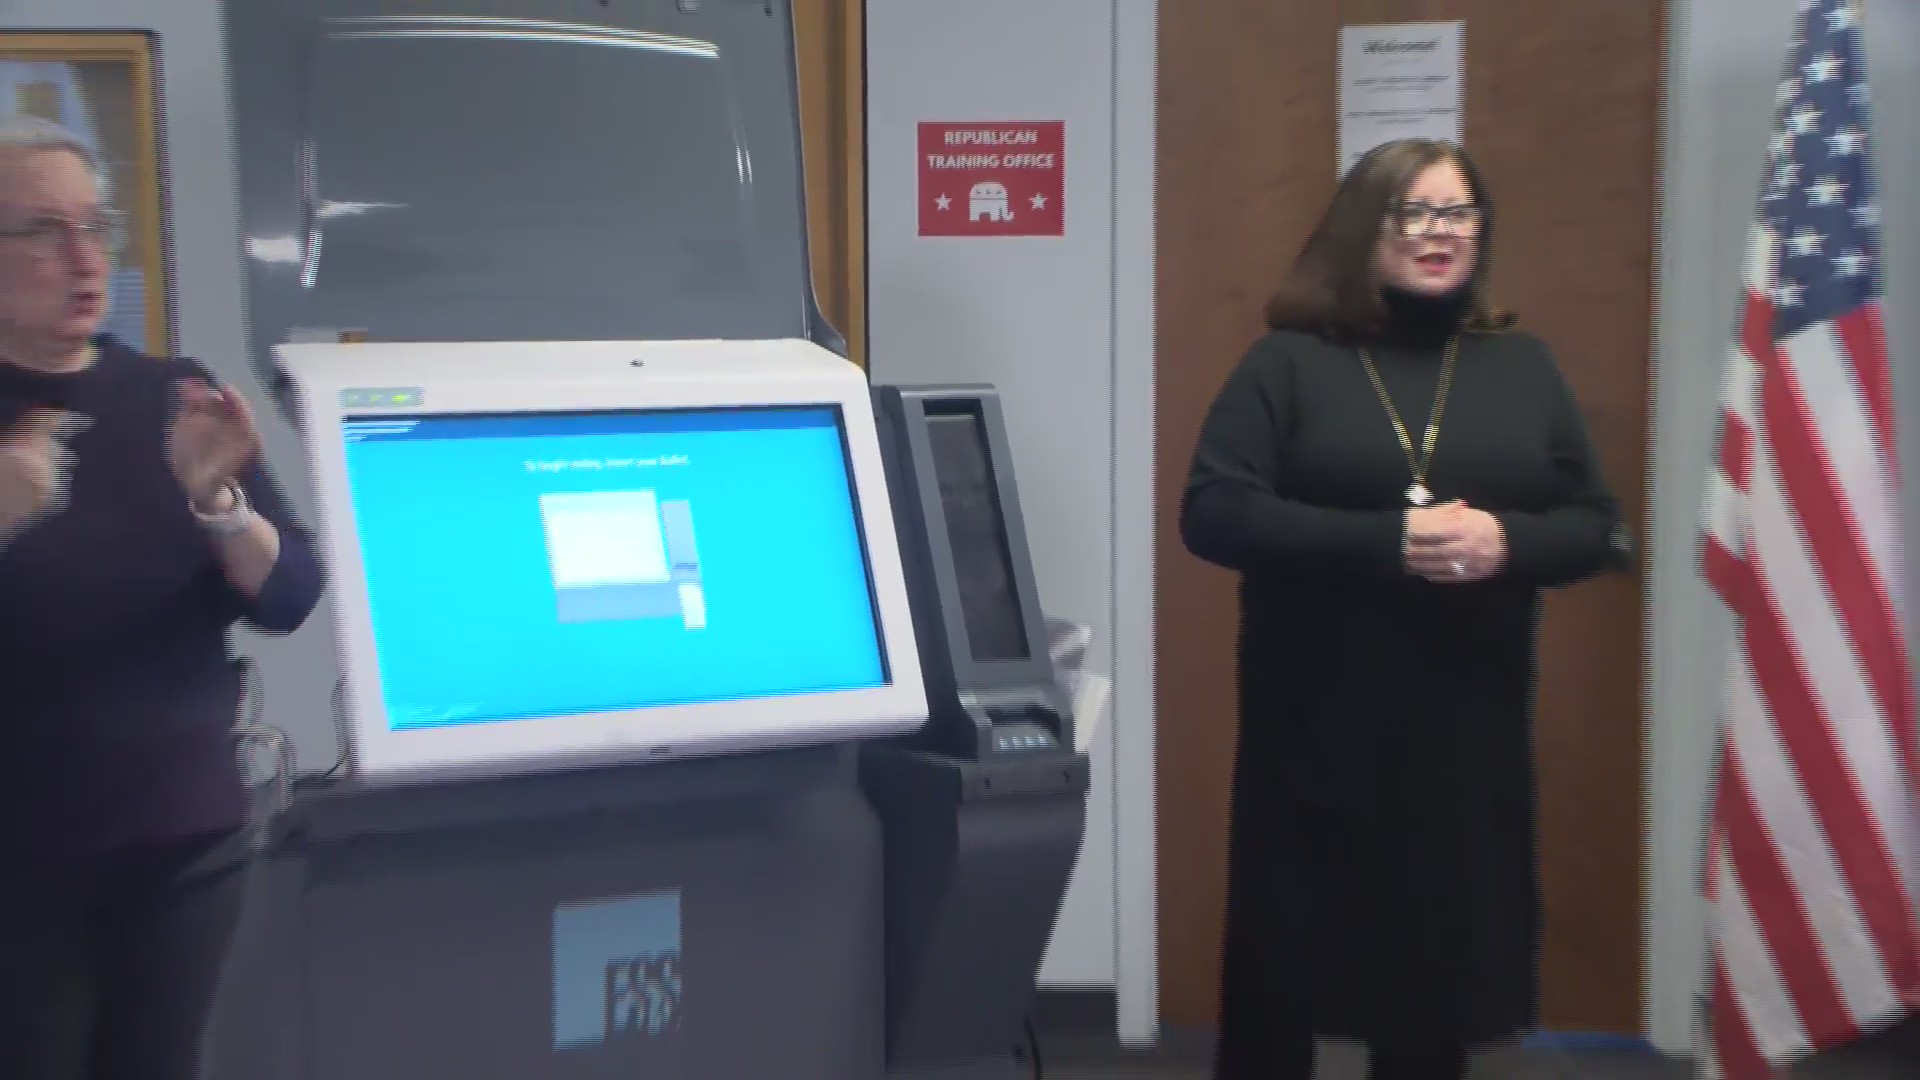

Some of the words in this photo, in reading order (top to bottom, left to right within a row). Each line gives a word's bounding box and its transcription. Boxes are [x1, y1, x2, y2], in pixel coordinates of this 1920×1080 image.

[944, 130, 1038, 145] REPUBLICAN
[927, 153, 1000, 169] TRAINING
[1002, 153, 1055, 169] OFFICE
